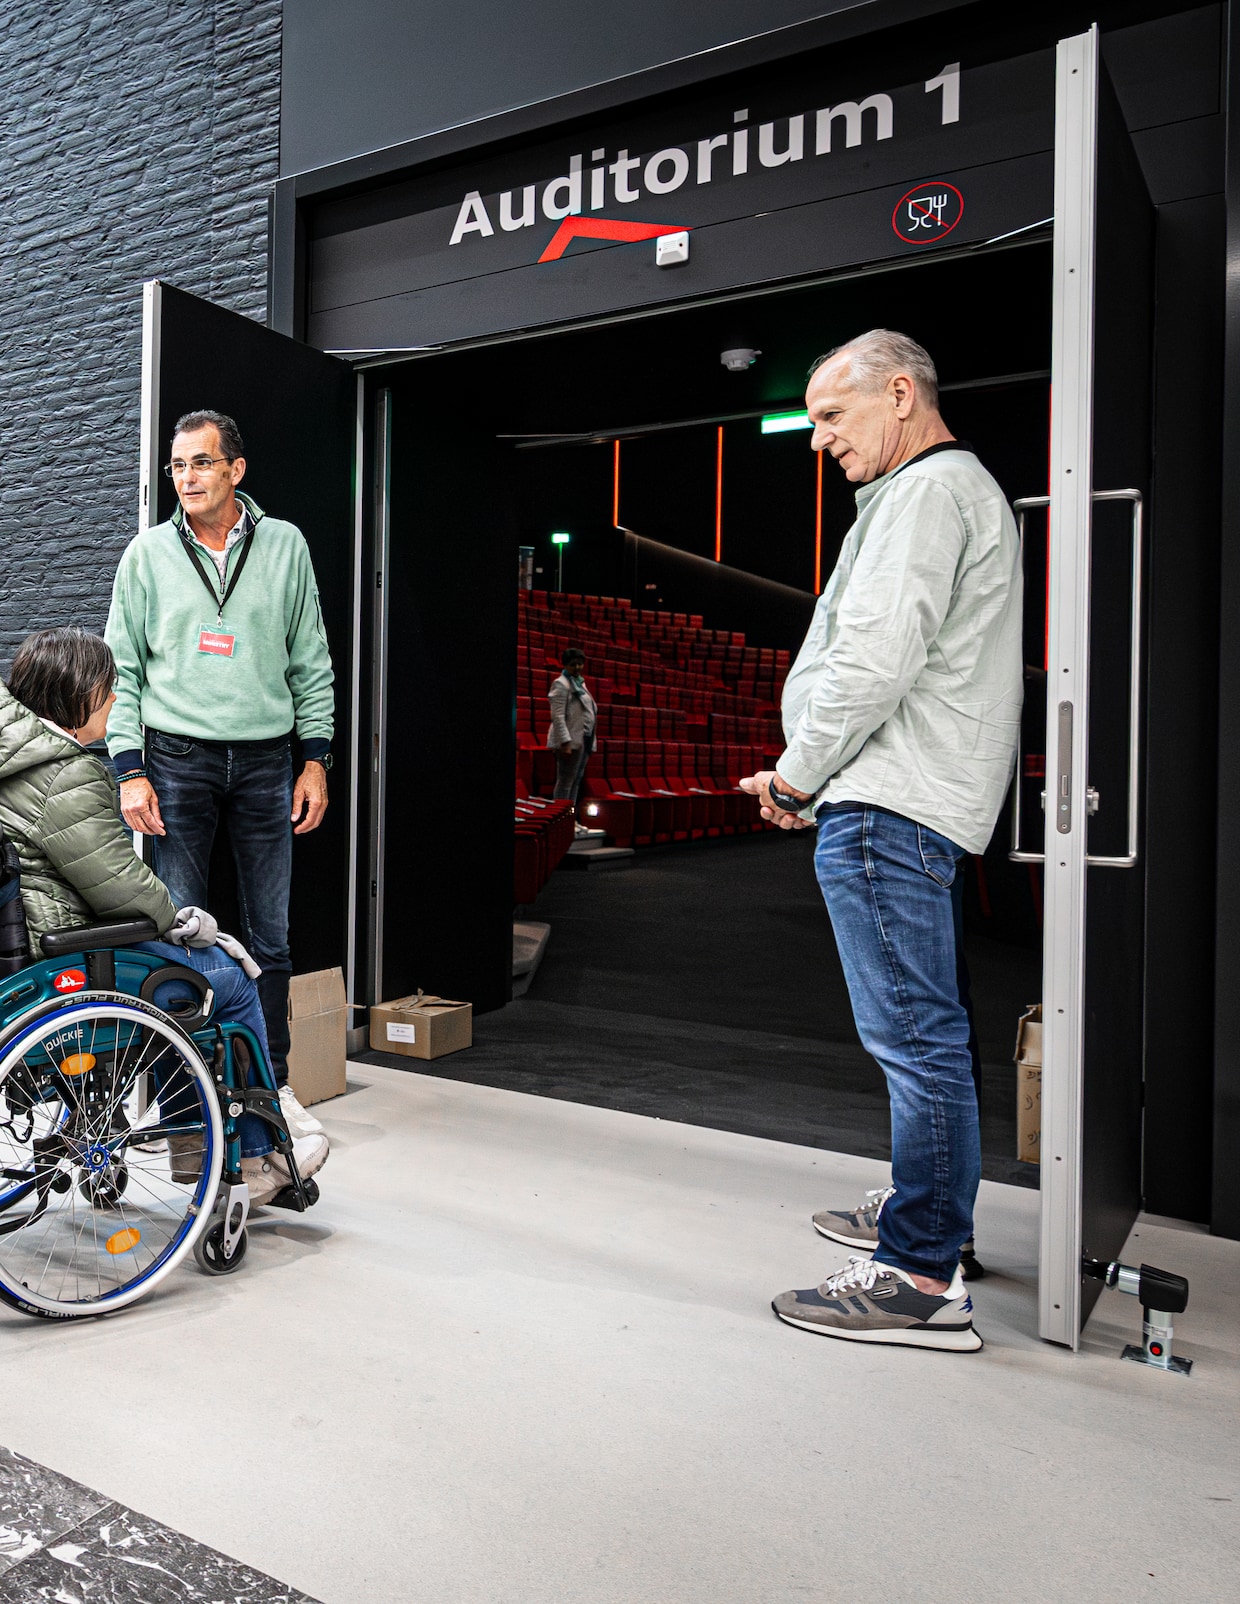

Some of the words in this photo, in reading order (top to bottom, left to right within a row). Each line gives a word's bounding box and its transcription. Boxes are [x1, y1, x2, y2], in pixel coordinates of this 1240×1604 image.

[449, 91, 893, 245] Auditorium
[925, 62, 961, 125] 1
[74, 994, 107, 1004] PLUS
[45, 1028, 84, 1052] QUCKIE
